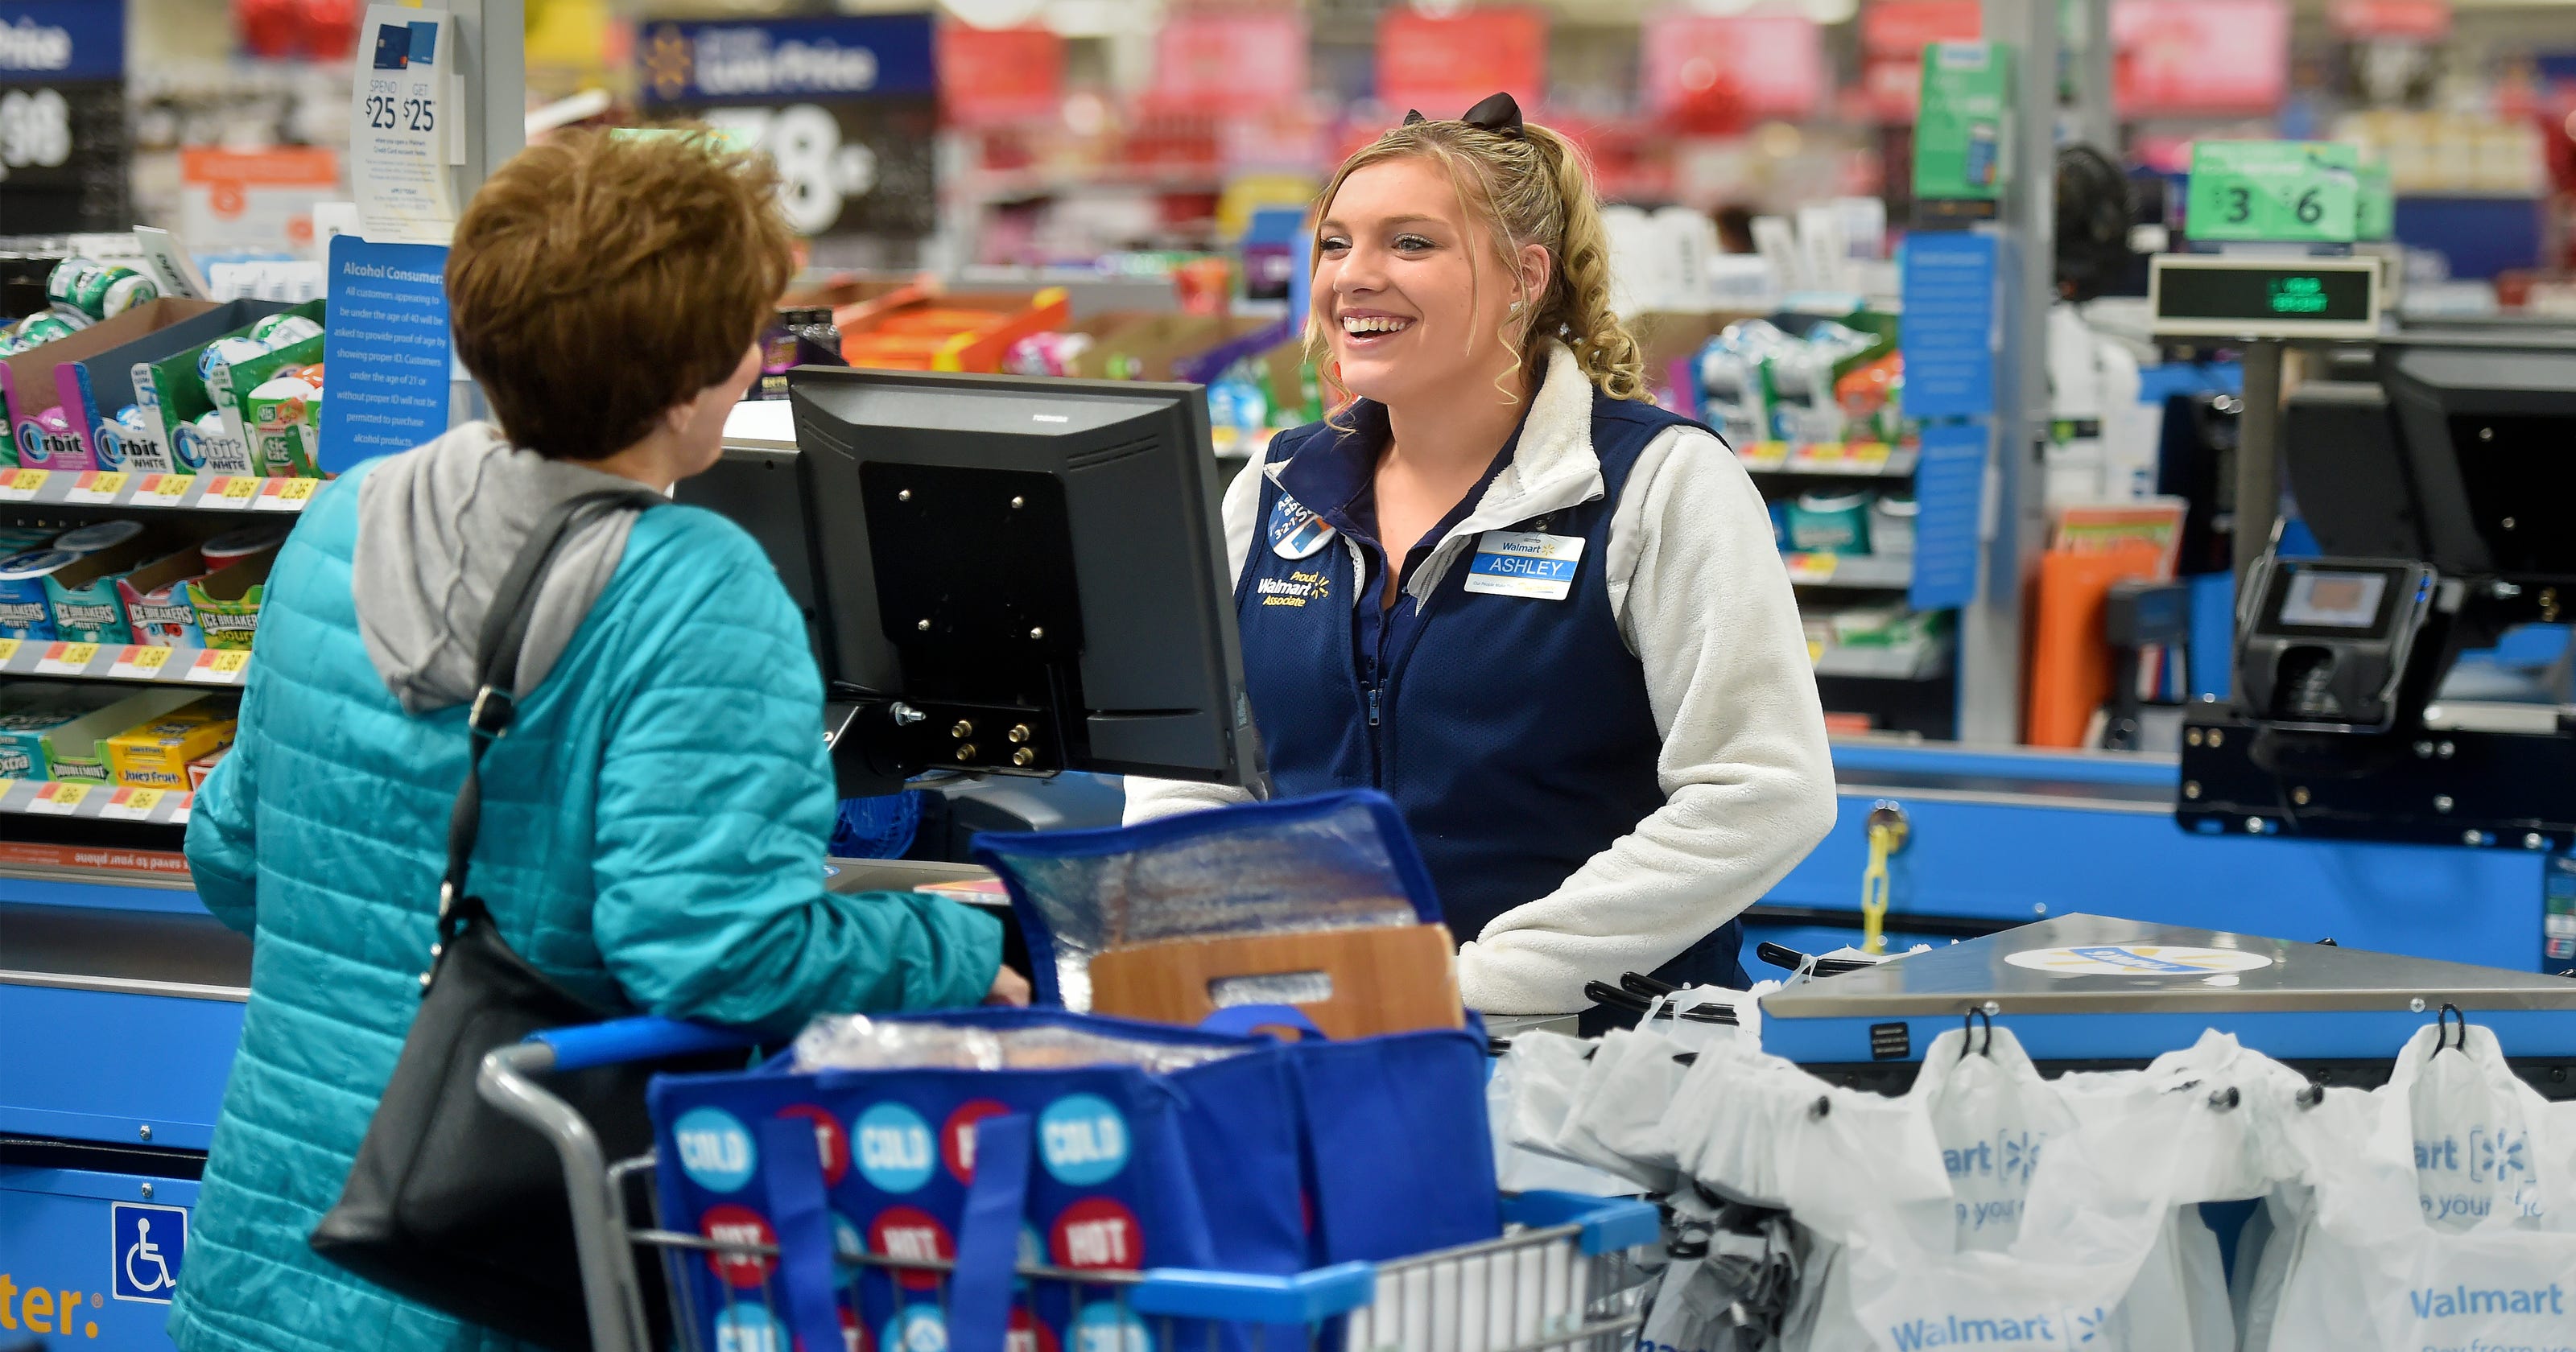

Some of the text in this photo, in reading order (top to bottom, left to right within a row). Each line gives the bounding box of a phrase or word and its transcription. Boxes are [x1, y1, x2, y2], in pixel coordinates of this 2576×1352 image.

[370, 79, 428, 97] SPEND GET
[365, 94, 396, 130] $25
[343, 262, 444, 284] Alcohol Consumer:
[345, 286, 440, 306] All customers appearing to
[340, 307, 443, 326] be under the age of 40 will be
[334, 328, 446, 348] asked to provide proof of age by
[336, 349, 367, 362] showing
[368, 352, 392, 364] proper
[404, 354, 442, 367] Customers
[349, 371, 427, 386] under the age of 21 or
[336, 390, 437, 407] without proper ID will not be
[346, 413, 424, 427] permitted to purchase
[20, 422, 84, 461] Orbit
[97, 428, 161, 467] Orbit
[174, 427, 245, 468] Orbit
[353, 434, 380, 444] alcohol
[130, 459, 166, 469] WHITE
[209, 460, 246, 470] WHITE
[282, 482, 309, 499] 2.96
[1503, 542, 1541, 554] Walmart
[1489, 558, 1564, 576] ASHLEY
[1290, 571, 1319, 583] Proud
[1257, 578, 1312, 596] Walmart
[1262, 595, 1307, 607] Associate
[70, 604, 116, 624] BREAKERS
[129, 604, 194, 624] ICE BREAKERS
[200, 612, 218, 628] ICE
[53, 763, 105, 778] DOUBLEMINT
[124, 770, 180, 785] Juicy Fruit
[74, 851, 108, 867] phone
[110, 854, 134, 867] your
[136, 857, 147, 868] to
[151, 857, 181, 870] saved
[858, 1125, 930, 1170] COLD
[1044, 1115, 1125, 1164] COLD
[676, 1130, 749, 1173] COLD
[883, 1226, 940, 1263] HOT
[1064, 1218, 1127, 1267] HOT
[1891, 1313, 2055, 1352] Walmart
